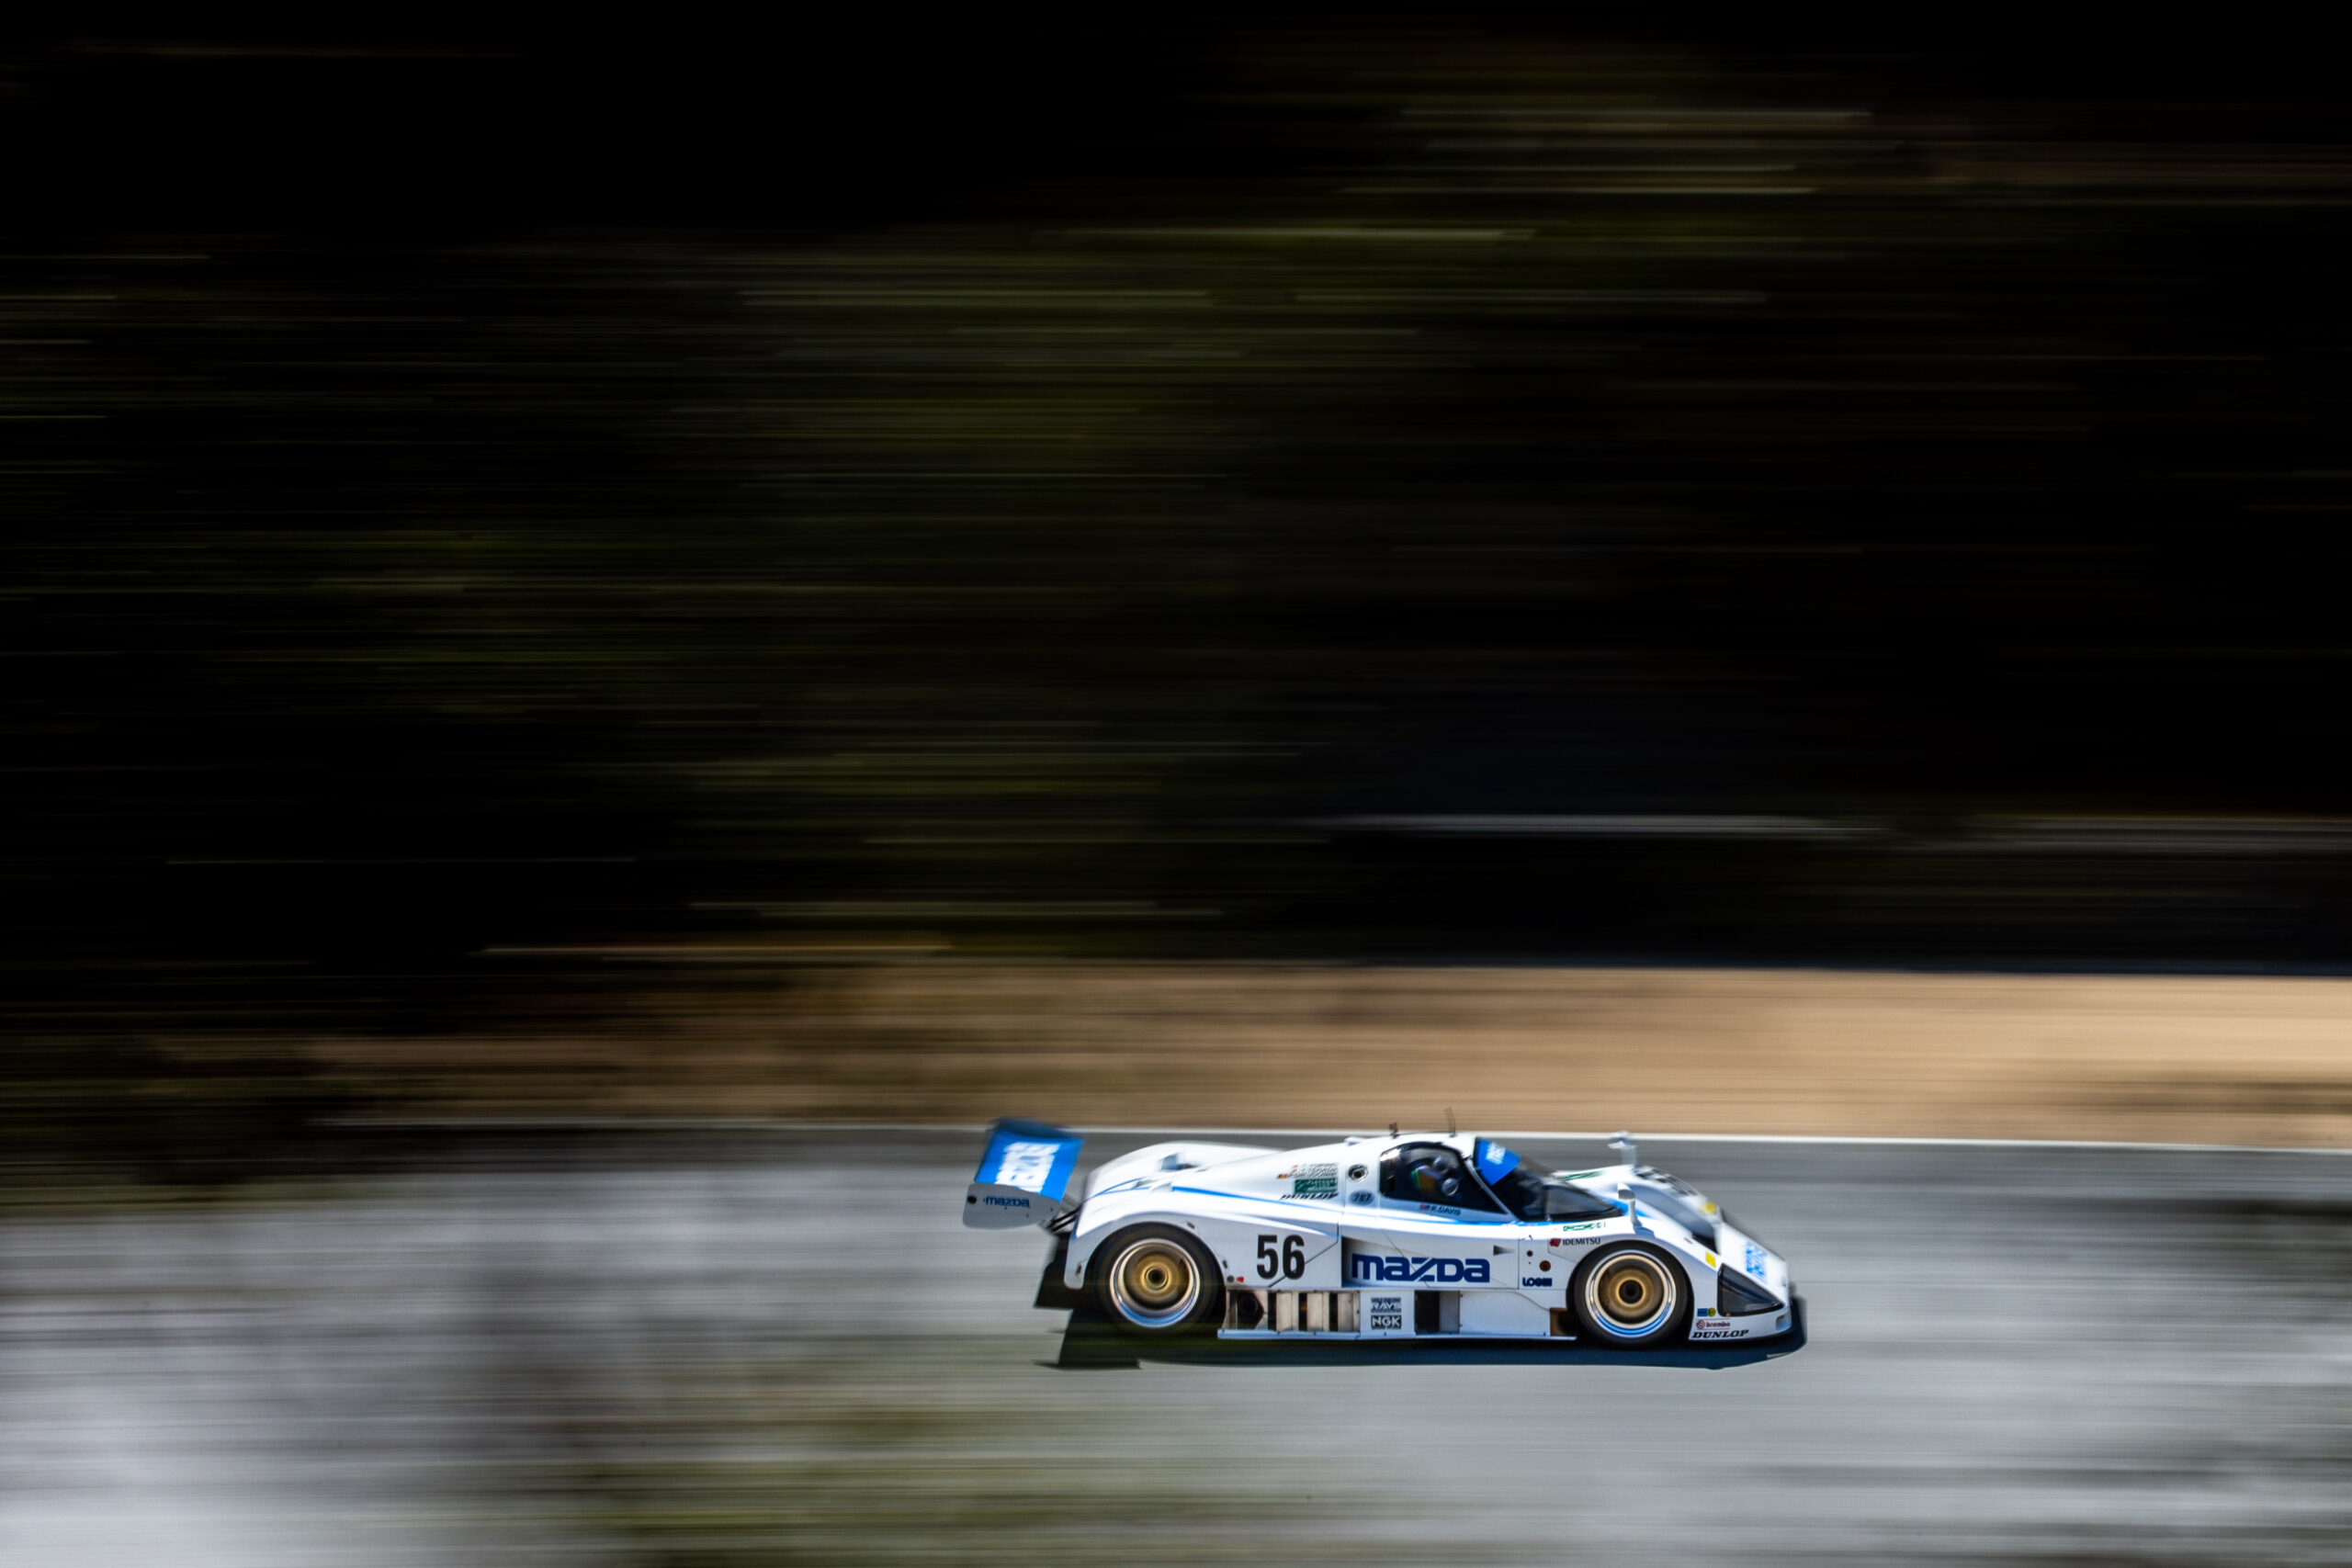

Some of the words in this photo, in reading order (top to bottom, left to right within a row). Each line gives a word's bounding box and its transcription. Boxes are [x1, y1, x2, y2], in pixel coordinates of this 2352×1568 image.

[1562, 1237, 1601, 1247] IDEMITSU
[1257, 1235, 1306, 1280] 56
[1372, 1315, 1401, 1327] NGK
[1691, 1329, 1750, 1339] DUNLOP
